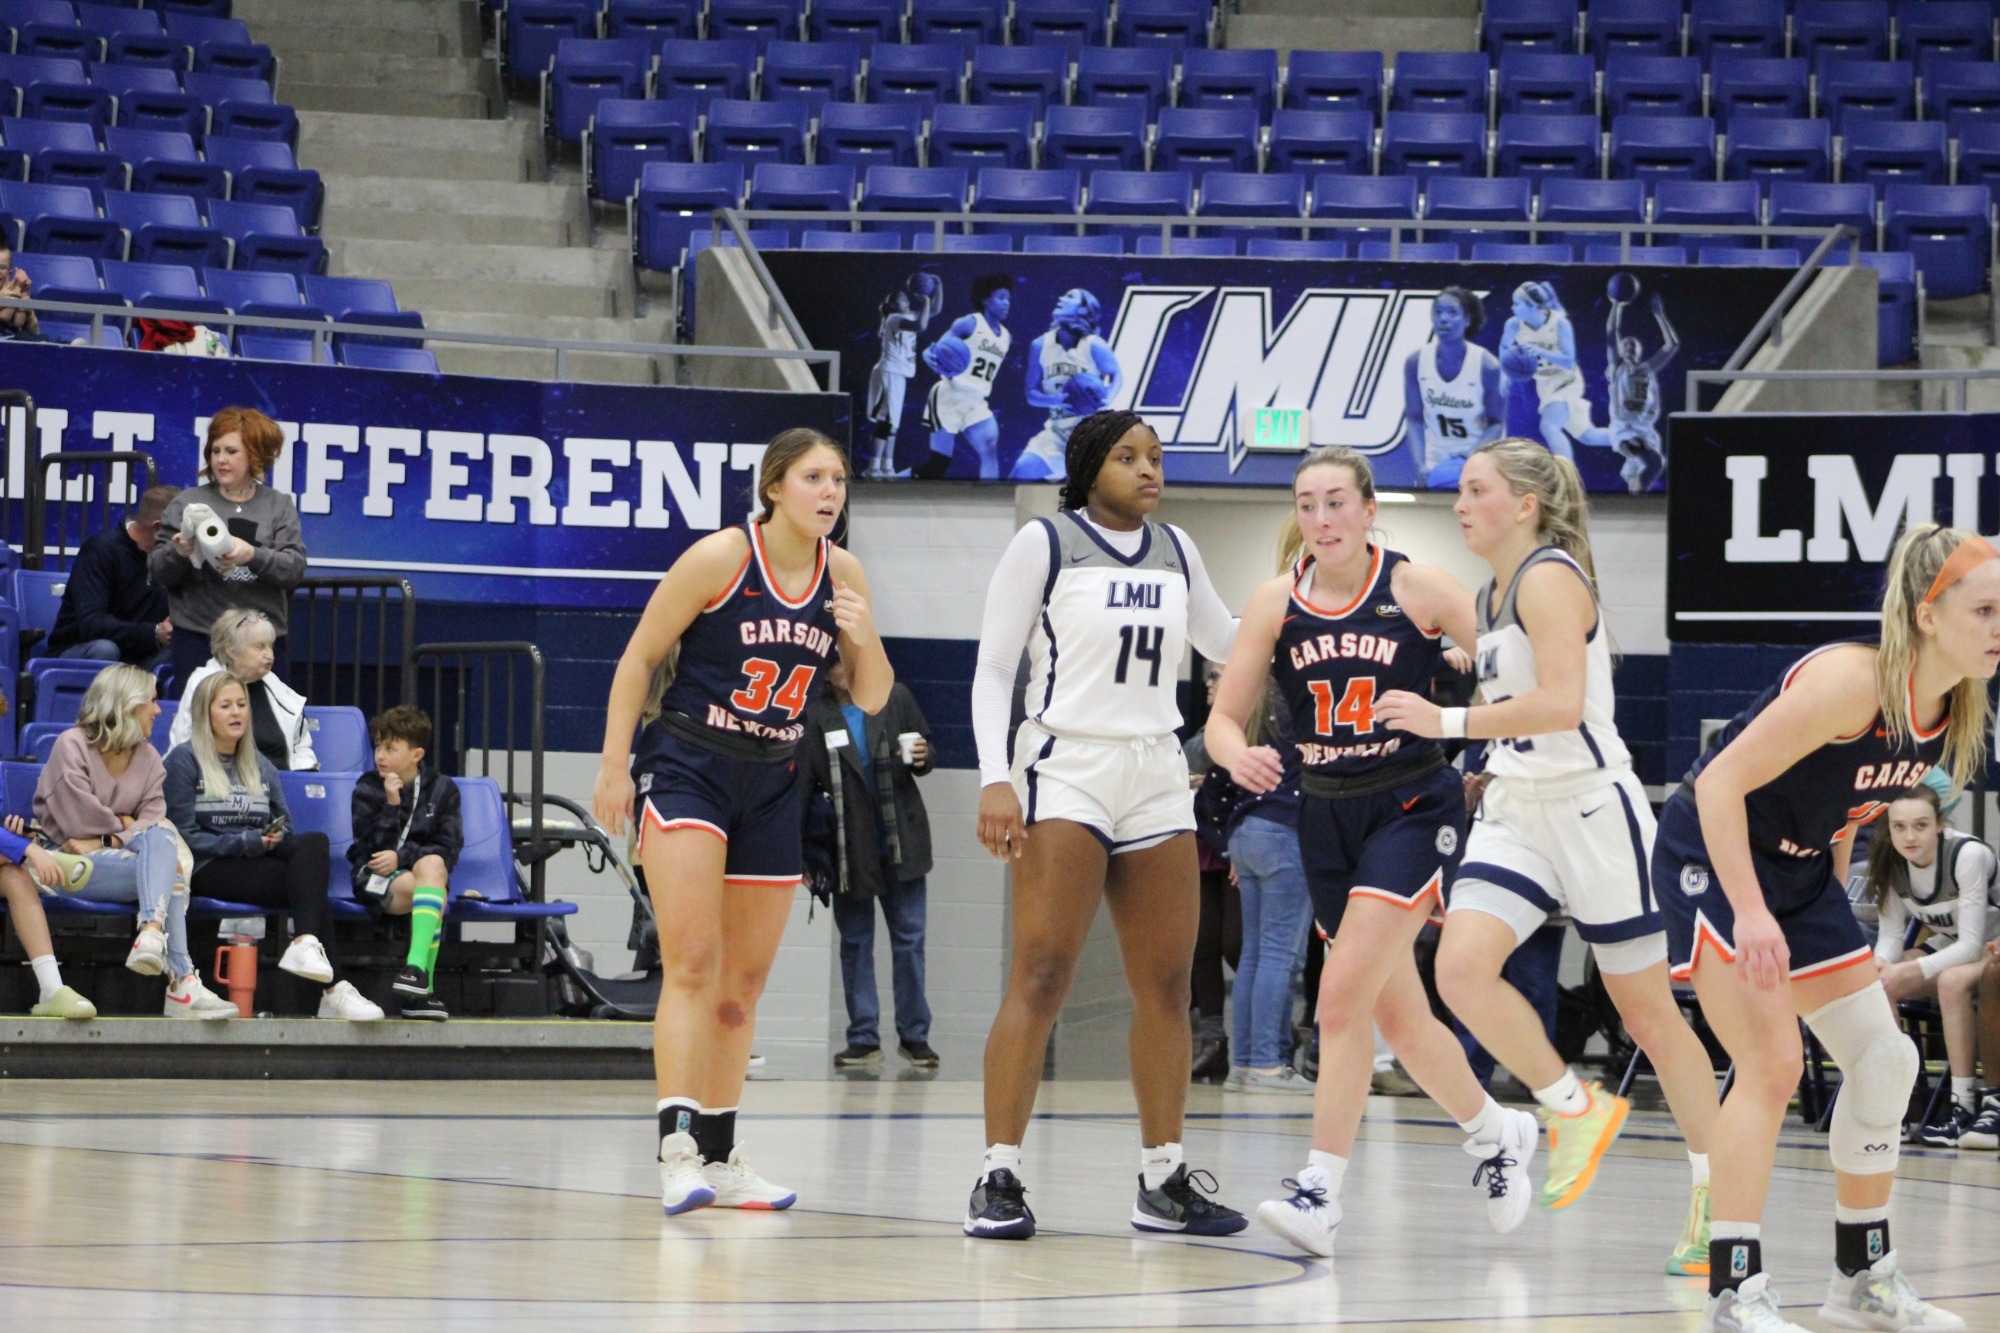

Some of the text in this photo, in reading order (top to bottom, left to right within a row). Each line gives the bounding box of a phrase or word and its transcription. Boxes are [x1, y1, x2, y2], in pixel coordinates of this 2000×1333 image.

[1105, 285, 1490, 474] LMU
[1255, 409, 1302, 446] EXIT
[1437, 414, 1468, 438] 15
[195, 416, 770, 530] IFFEREN
[1105, 580, 1166, 611] LMU
[740, 618, 833, 658] CARSON
[1114, 625, 1164, 687] 14
[1290, 633, 1398, 669] CARSON
[730, 656, 817, 720] 34
[1307, 676, 1377, 736] 14
